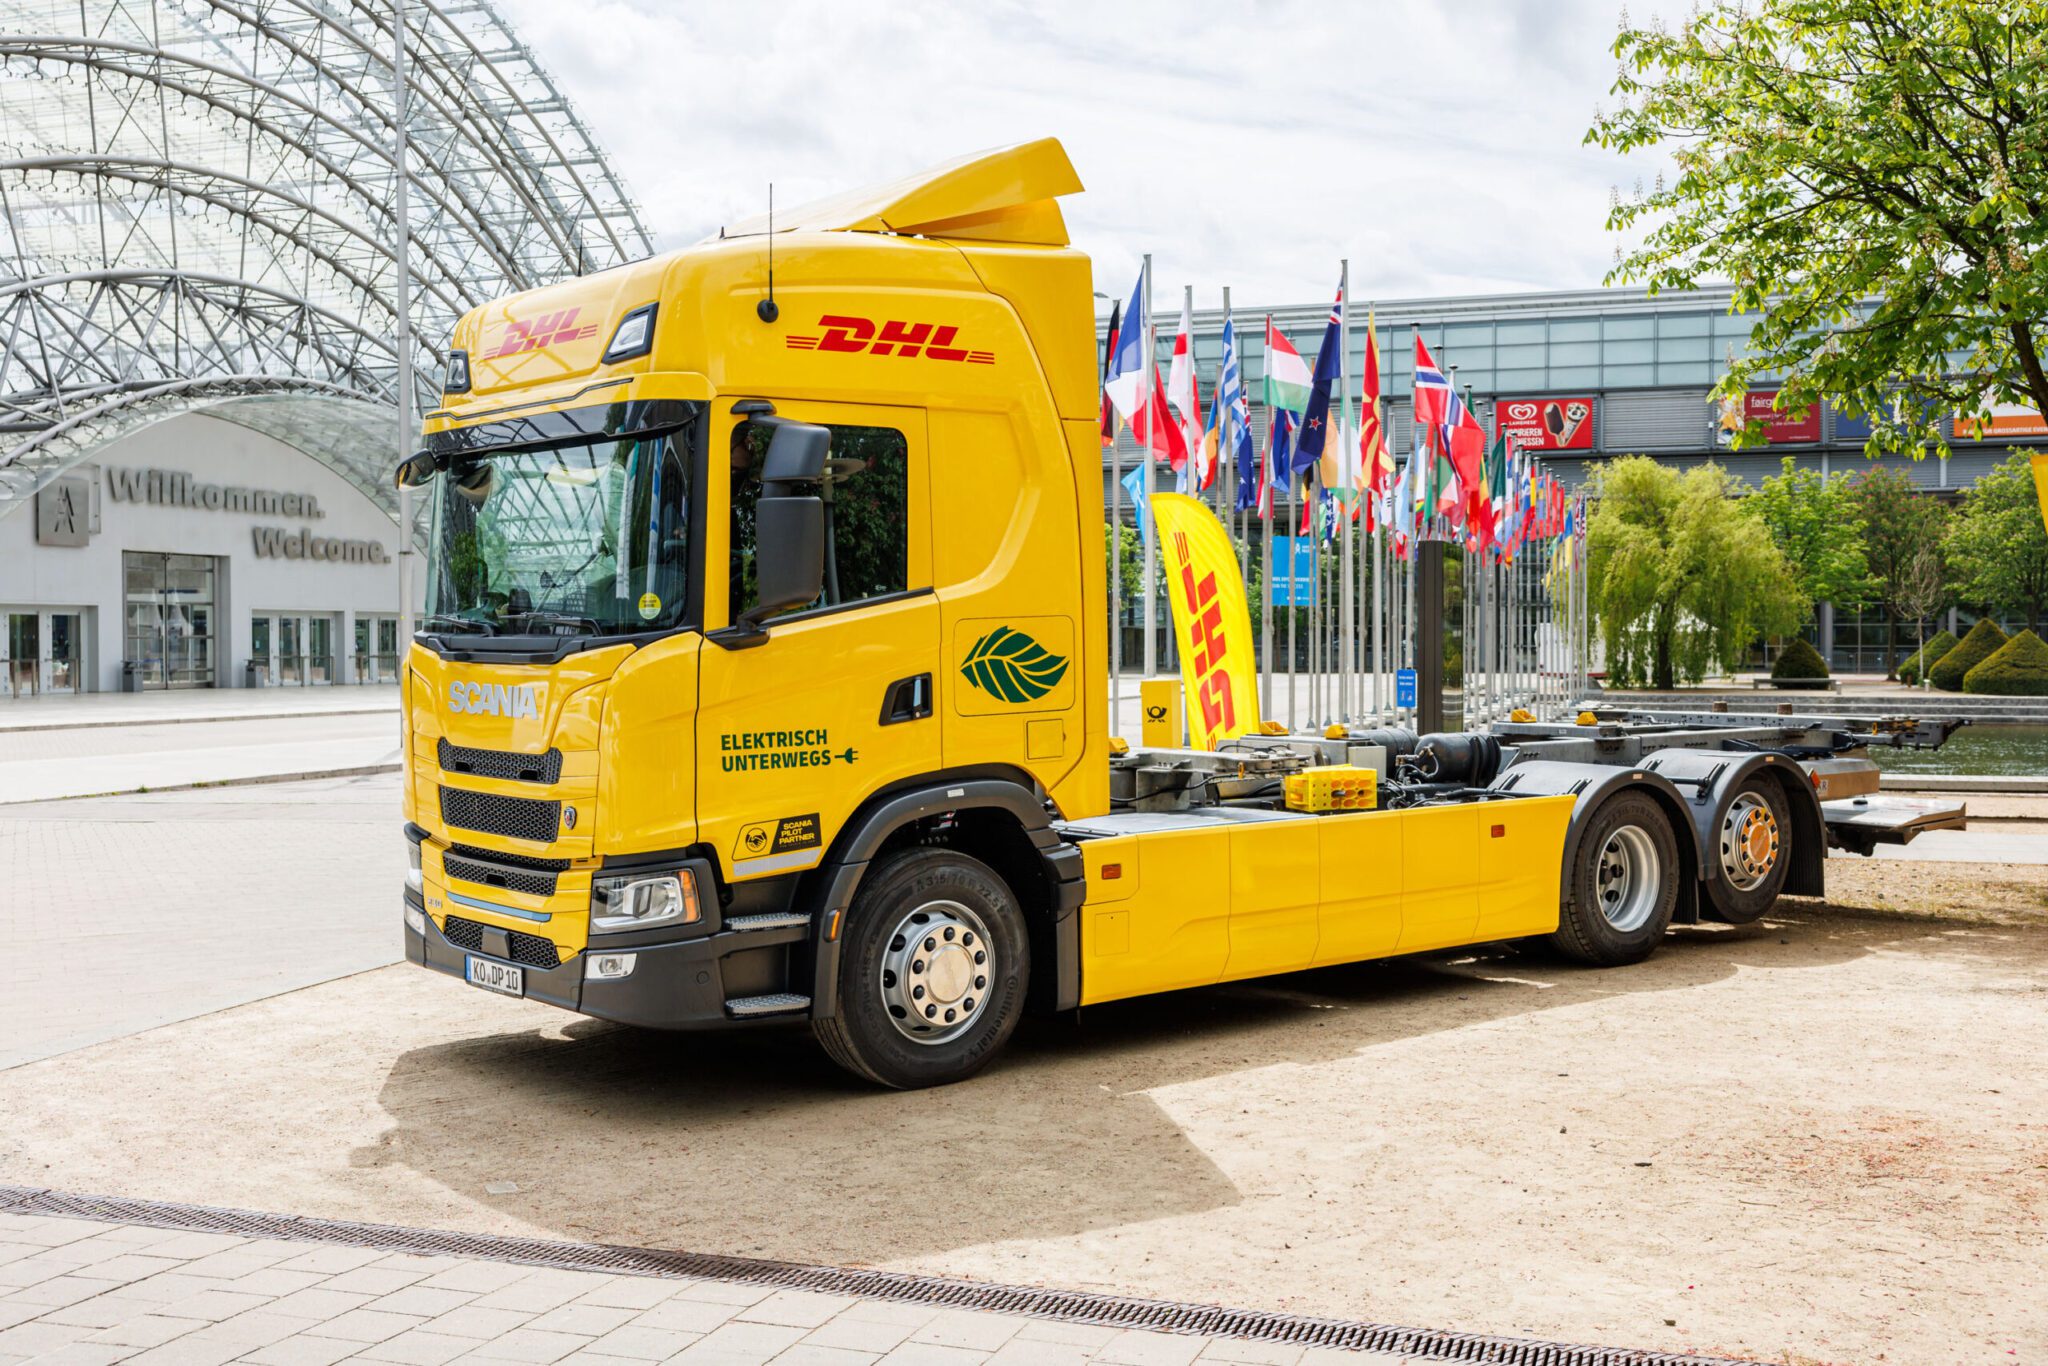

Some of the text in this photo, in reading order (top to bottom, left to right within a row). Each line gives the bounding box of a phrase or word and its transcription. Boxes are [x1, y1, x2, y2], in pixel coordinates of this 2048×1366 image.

[500, 307, 581, 356] DHL
[818, 315, 968, 362] DHL
[108, 467, 326, 518] Willkommen.
[252, 526, 391, 564] Welcome.
[1182, 562, 1236, 736] DHL
[448, 681, 539, 720] SCANIA
[720, 729, 828, 751] ELEKTRISCH
[721, 749, 831, 772] UNTERWEGS
[779, 833, 815, 844] PARTNER
[781, 827, 803, 837] PILOT
[783, 820, 812, 830] SCANIA
[473, 960, 518, 991] KO DP 10
[977, 975, 1019, 1052] Continental
